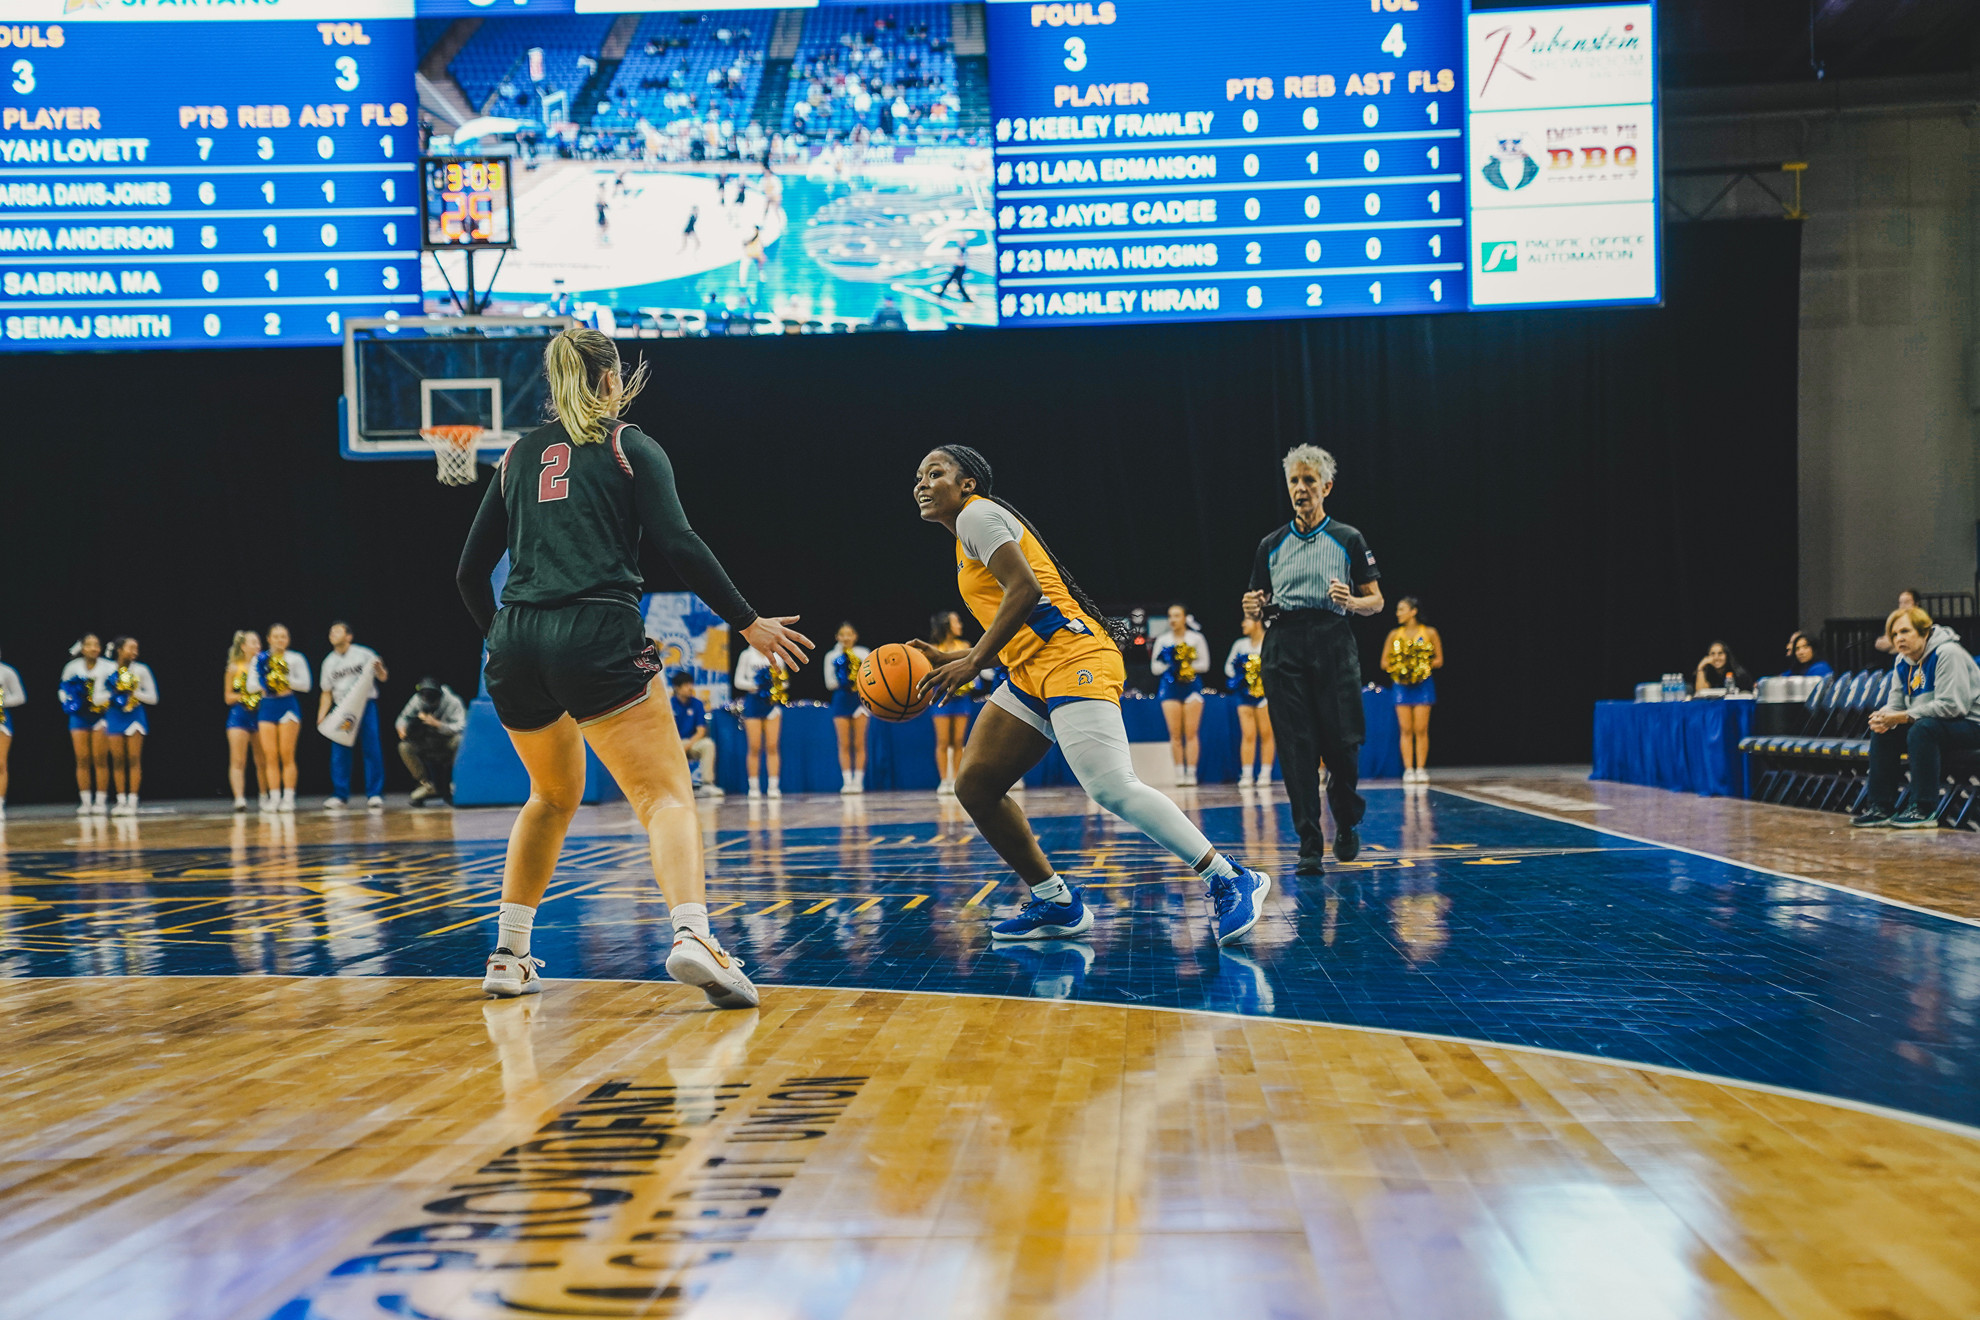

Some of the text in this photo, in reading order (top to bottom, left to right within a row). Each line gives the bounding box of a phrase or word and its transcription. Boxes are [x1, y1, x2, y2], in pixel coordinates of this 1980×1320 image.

[1031, 2, 1116, 27] FOULS
[317, 23, 370, 45] TOL
[1064, 24, 1406, 71] 3 4
[13, 57, 358, 93] 3 3
[1479, 23, 1639, 98] Rubenstein
[1055, 69, 1454, 107] PLAYER PTS REB AST FLS
[3, 103, 408, 130] PLAYER PTS REB AST FLS
[1030, 115, 1111, 139] KEELEY
[1115, 111, 1214, 136] FRAWLEY
[1243, 110, 1258, 132] 0
[1303, 107, 1318, 129] 6
[1364, 105, 1378, 127] 0
[1427, 102, 1437, 124] 1
[0, 136, 392, 161] YAH LOVETT 7 3 0 1
[1042, 160, 1097, 183] LARA
[1101, 155, 1216, 181] EDMANSON
[1244, 154, 1259, 176] 0
[1307, 152, 1318, 173] 1
[1364, 150, 1379, 171] 0
[1428, 147, 1438, 168] 1
[0, 179, 394, 206] ARISA DAVIS-JONES 6 1 1 1
[447, 163, 503, 192] 3:03
[1051, 203, 1128, 227] JAYDE
[1133, 200, 1216, 224] CADEE
[1245, 198, 1260, 220] 0
[1305, 196, 1320, 217] 0
[1365, 193, 1380, 215] 0
[1429, 191, 1439, 212] 1
[0, 223, 395, 250] MAYA ANDERSON 5 1 0 1
[1045, 248, 1119, 270] MARYA
[1123, 244, 1218, 268] HUDGINS
[1246, 242, 1261, 264] 2
[1306, 240, 1321, 261] 0
[1366, 238, 1381, 259] 0
[1429, 235, 1440, 256] 1
[5, 267, 398, 294] SABRINA MA 0 1 1 3
[1047, 291, 1137, 314] ASHLEY
[1142, 288, 1219, 311] HIRAKI
[1247, 286, 1262, 308] 8
[1307, 284, 1322, 306] 2
[1370, 282, 1381, 303] 1
[1430, 280, 1441, 301] 1
[7, 317, 90, 339] SEMAJ
[95, 315, 170, 337] SMITH
[204, 314, 220, 336] 0
[265, 313, 279, 335] 2
[327, 312, 339, 333] 1
[538, 442, 572, 503] 2
[723, 1075, 872, 1143] UNION
[328, 1078, 752, 1280] PROVIDENT
